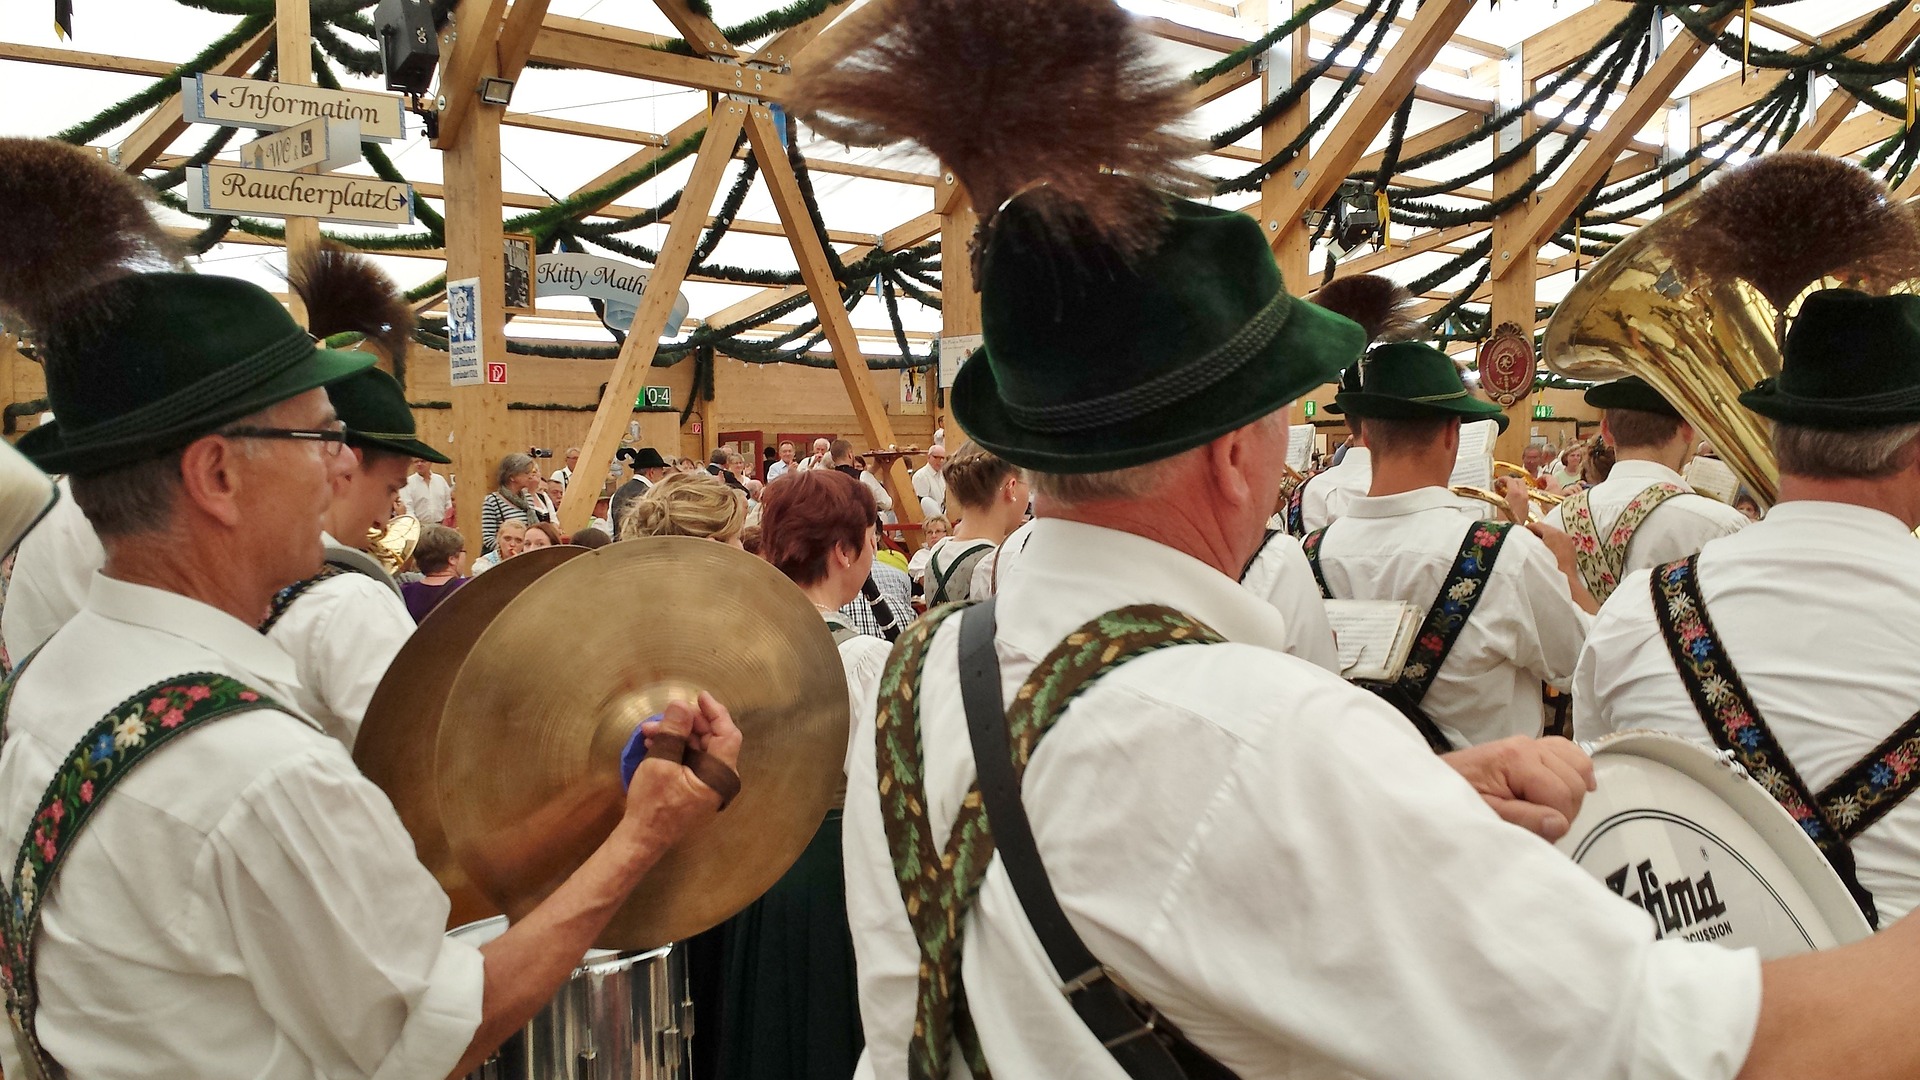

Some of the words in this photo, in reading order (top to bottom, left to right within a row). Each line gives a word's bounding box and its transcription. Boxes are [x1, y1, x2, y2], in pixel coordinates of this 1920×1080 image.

[229, 86, 379, 124] Information
[266, 136, 291, 167] WC
[538, 263, 588, 290] Kitty
